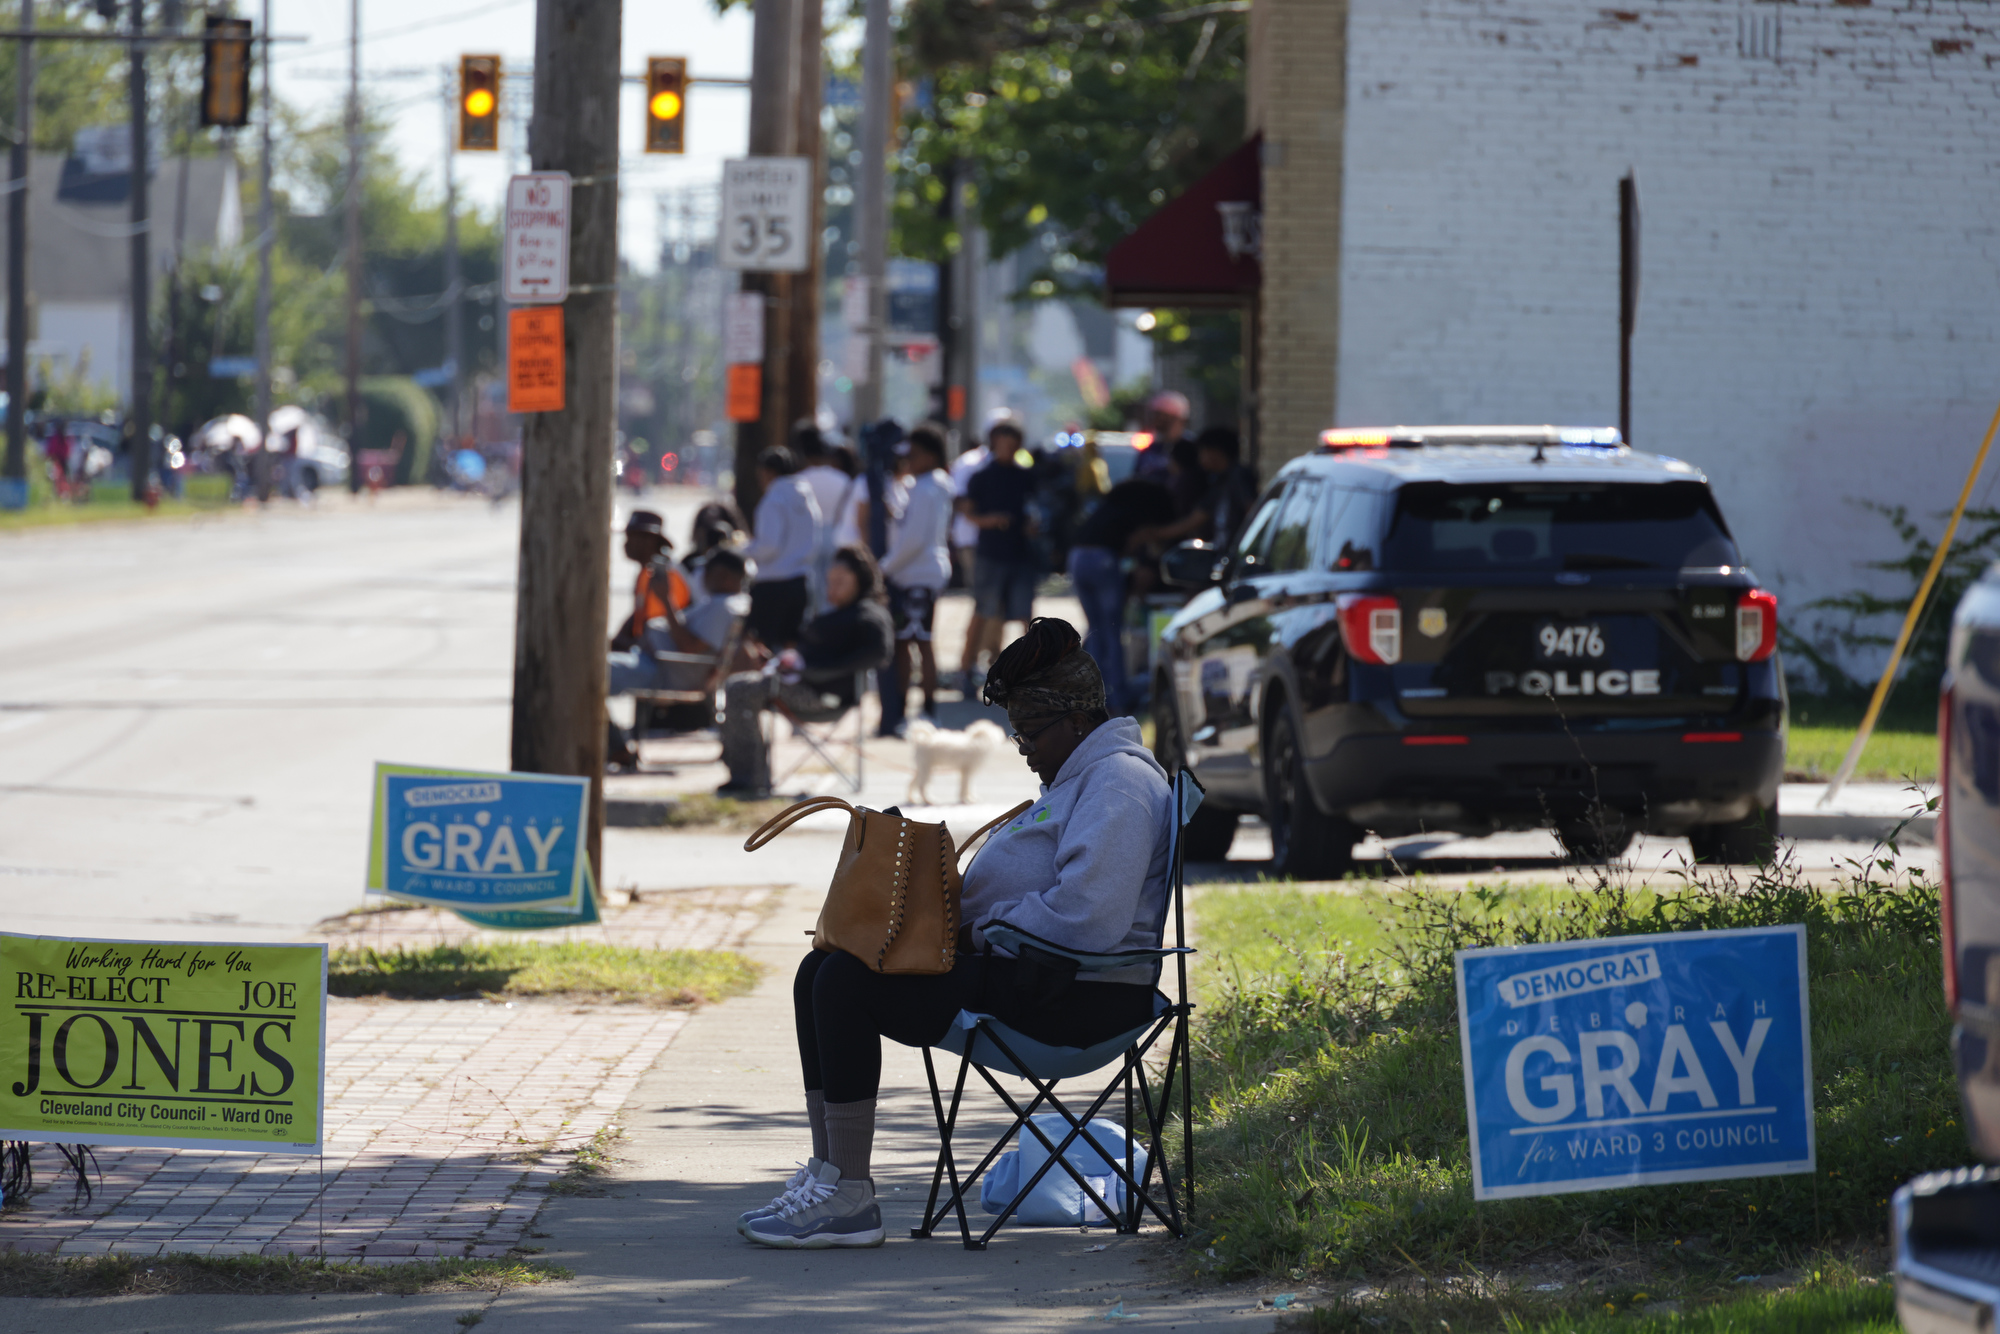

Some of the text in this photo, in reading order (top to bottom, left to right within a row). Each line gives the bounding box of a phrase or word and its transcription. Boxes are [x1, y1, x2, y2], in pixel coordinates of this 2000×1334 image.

[525, 185, 552, 207] NO
[731, 215, 793, 257] 35
[1539, 625, 1604, 657] 9476
[1485, 669, 1661, 695] POLICE
[412, 785, 496, 802] DEMOCRAT
[401, 821, 565, 872] GRAY
[430, 878, 476, 894] WARD
[66, 946, 252, 977] Working Hard for You
[1512, 953, 1652, 1000] DEMOCRAT
[15, 971, 296, 1011] RE-ELECT JOE
[12, 1012, 295, 1097] JONES
[1505, 1018, 1773, 1124] GRAY
[40, 1099, 112, 1118] Cleveland
[117, 1103, 146, 1121] City
[151, 1104, 206, 1121] Council
[222, 1107, 260, 1123] Ward
[264, 1109, 293, 1125] One
[1518, 1124, 1780, 1178] for WARD 3 COUNCIL
